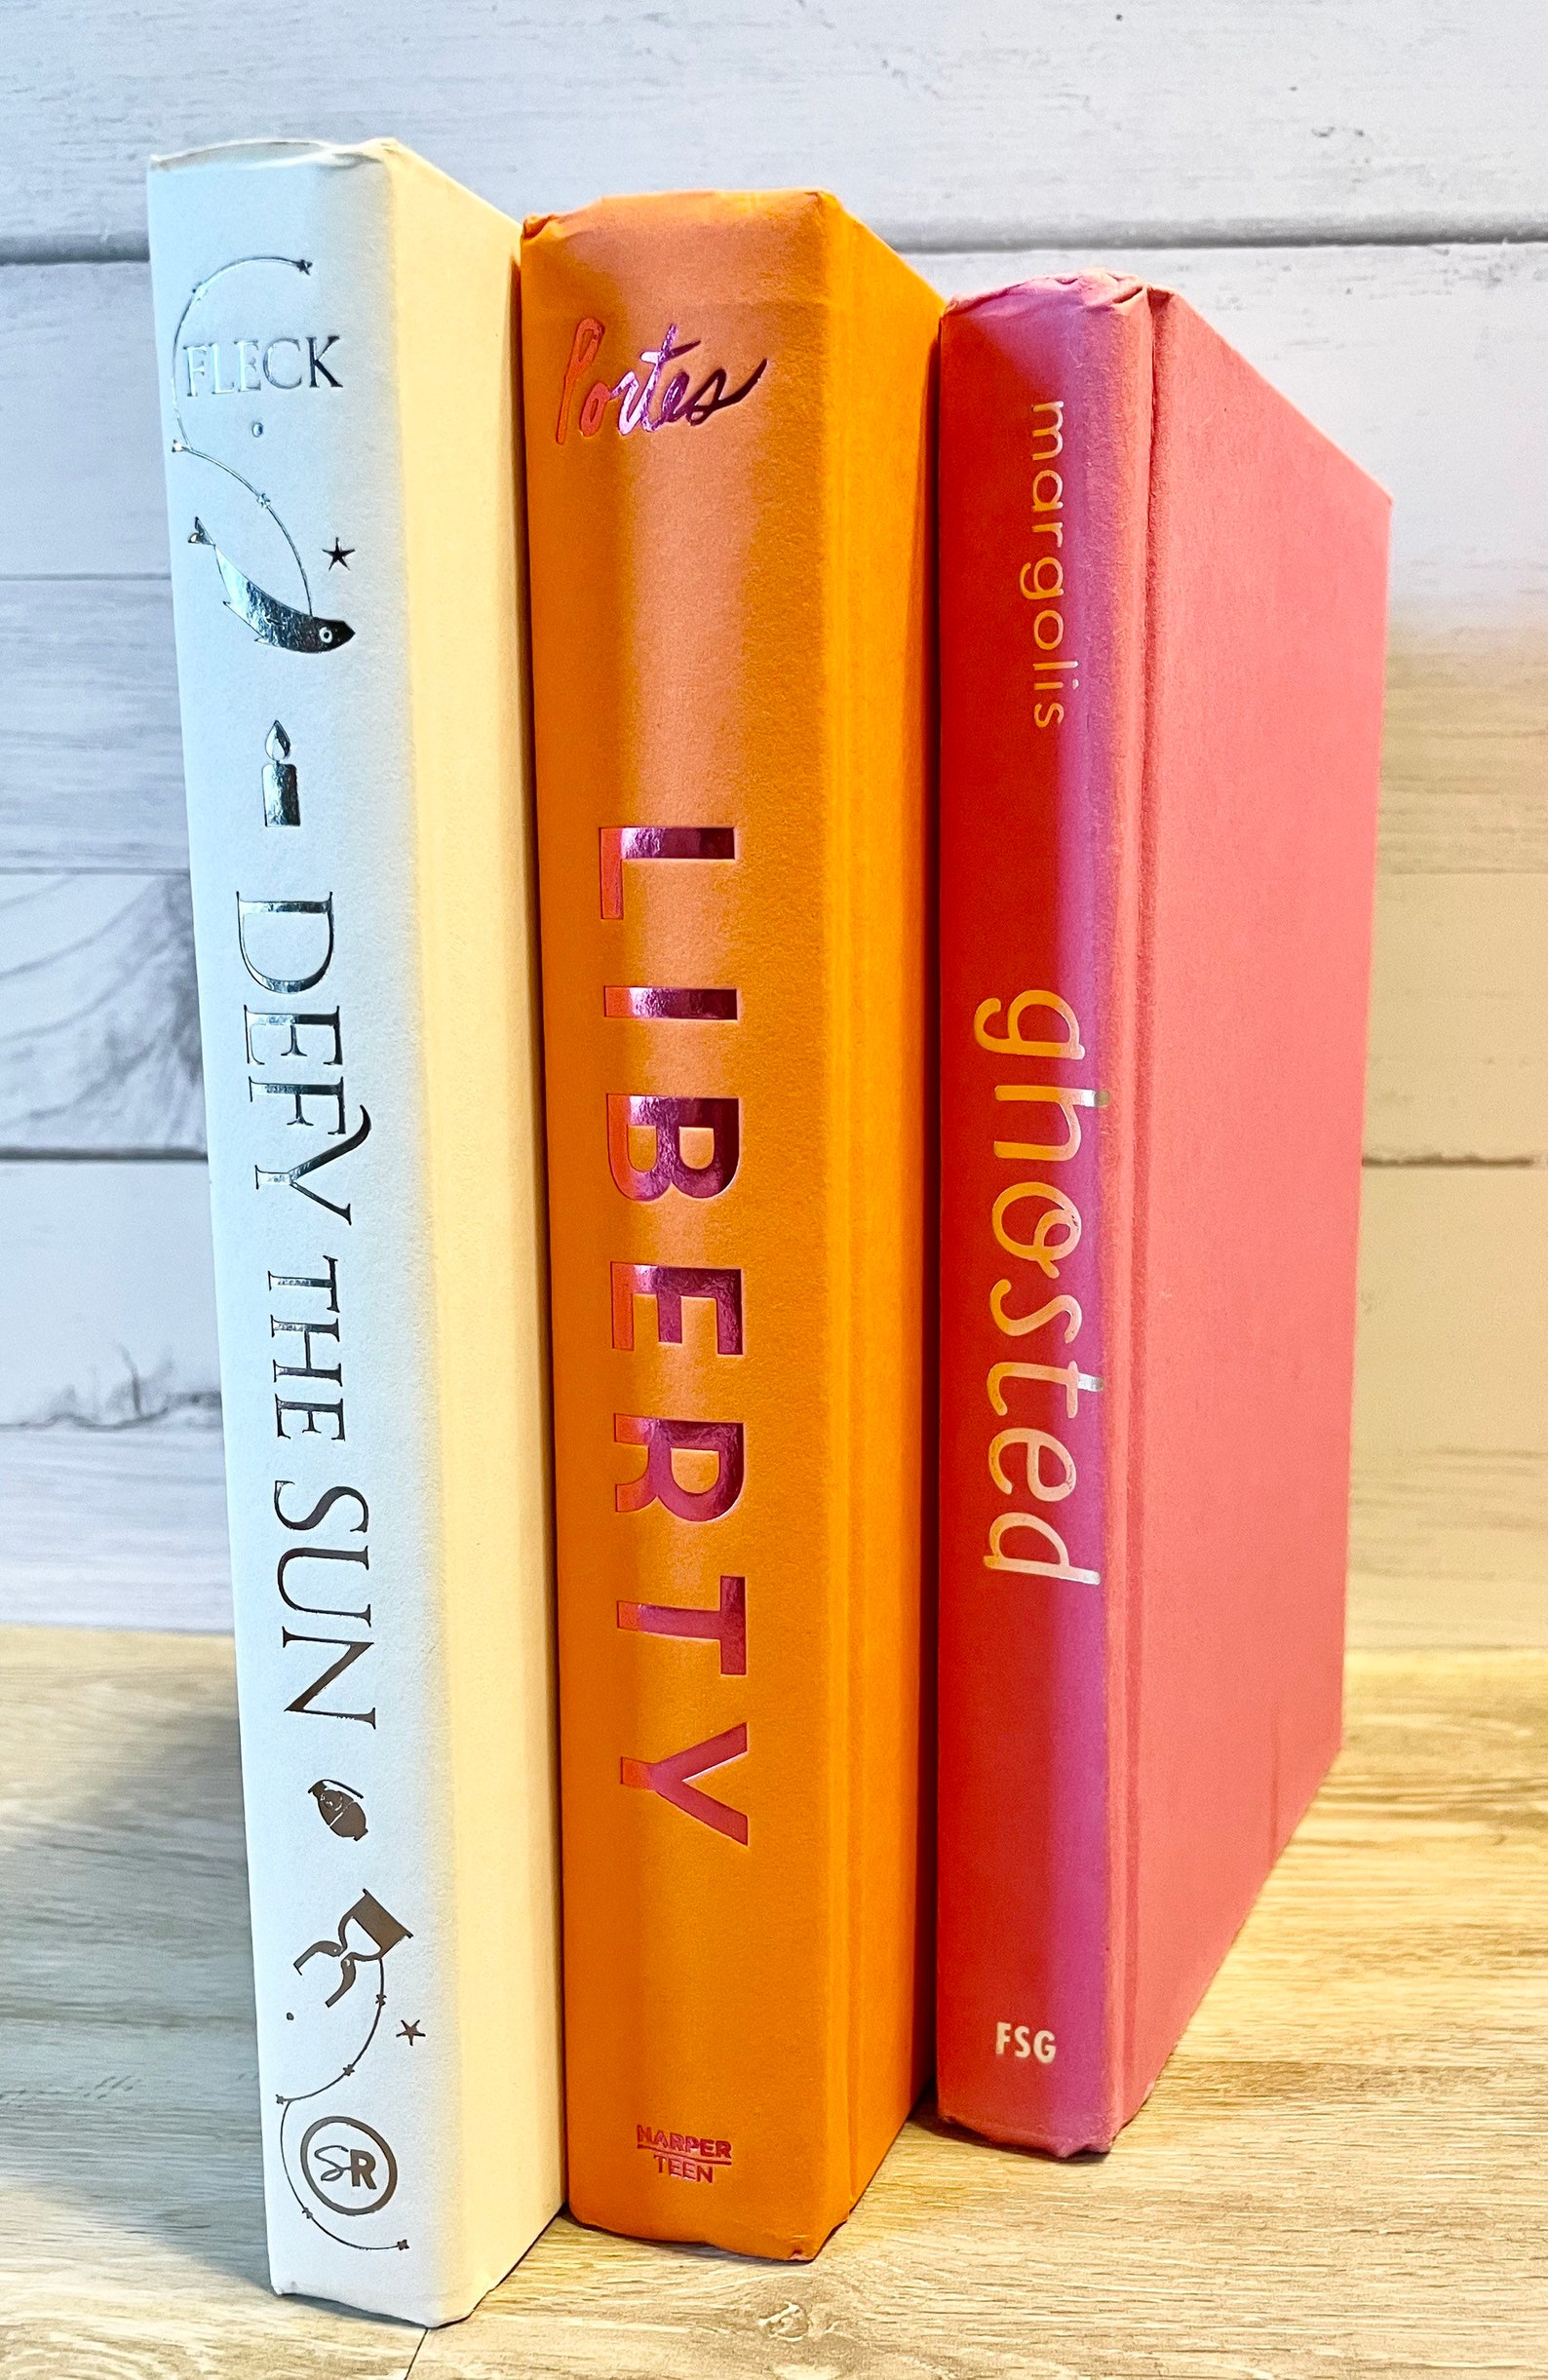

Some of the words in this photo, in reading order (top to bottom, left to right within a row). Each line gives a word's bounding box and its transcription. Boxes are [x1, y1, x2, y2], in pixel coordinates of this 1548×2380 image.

[183, 336, 343, 397] FLECK
[556, 318, 768, 444] Portes
[1020, 401, 1078, 728] margolis
[236, 891, 371, 1225] DEFY
[268, 1255, 346, 1441] THE
[599, 825, 750, 1847] LIBERTY
[975, 989, 1109, 1586] ghosted
[274, 1480, 376, 1730] SUN
[995, 2021, 1057, 2063] FSG
[637, 2125, 732, 2159] HARPER
[653, 2154, 714, 2183] TEEN
